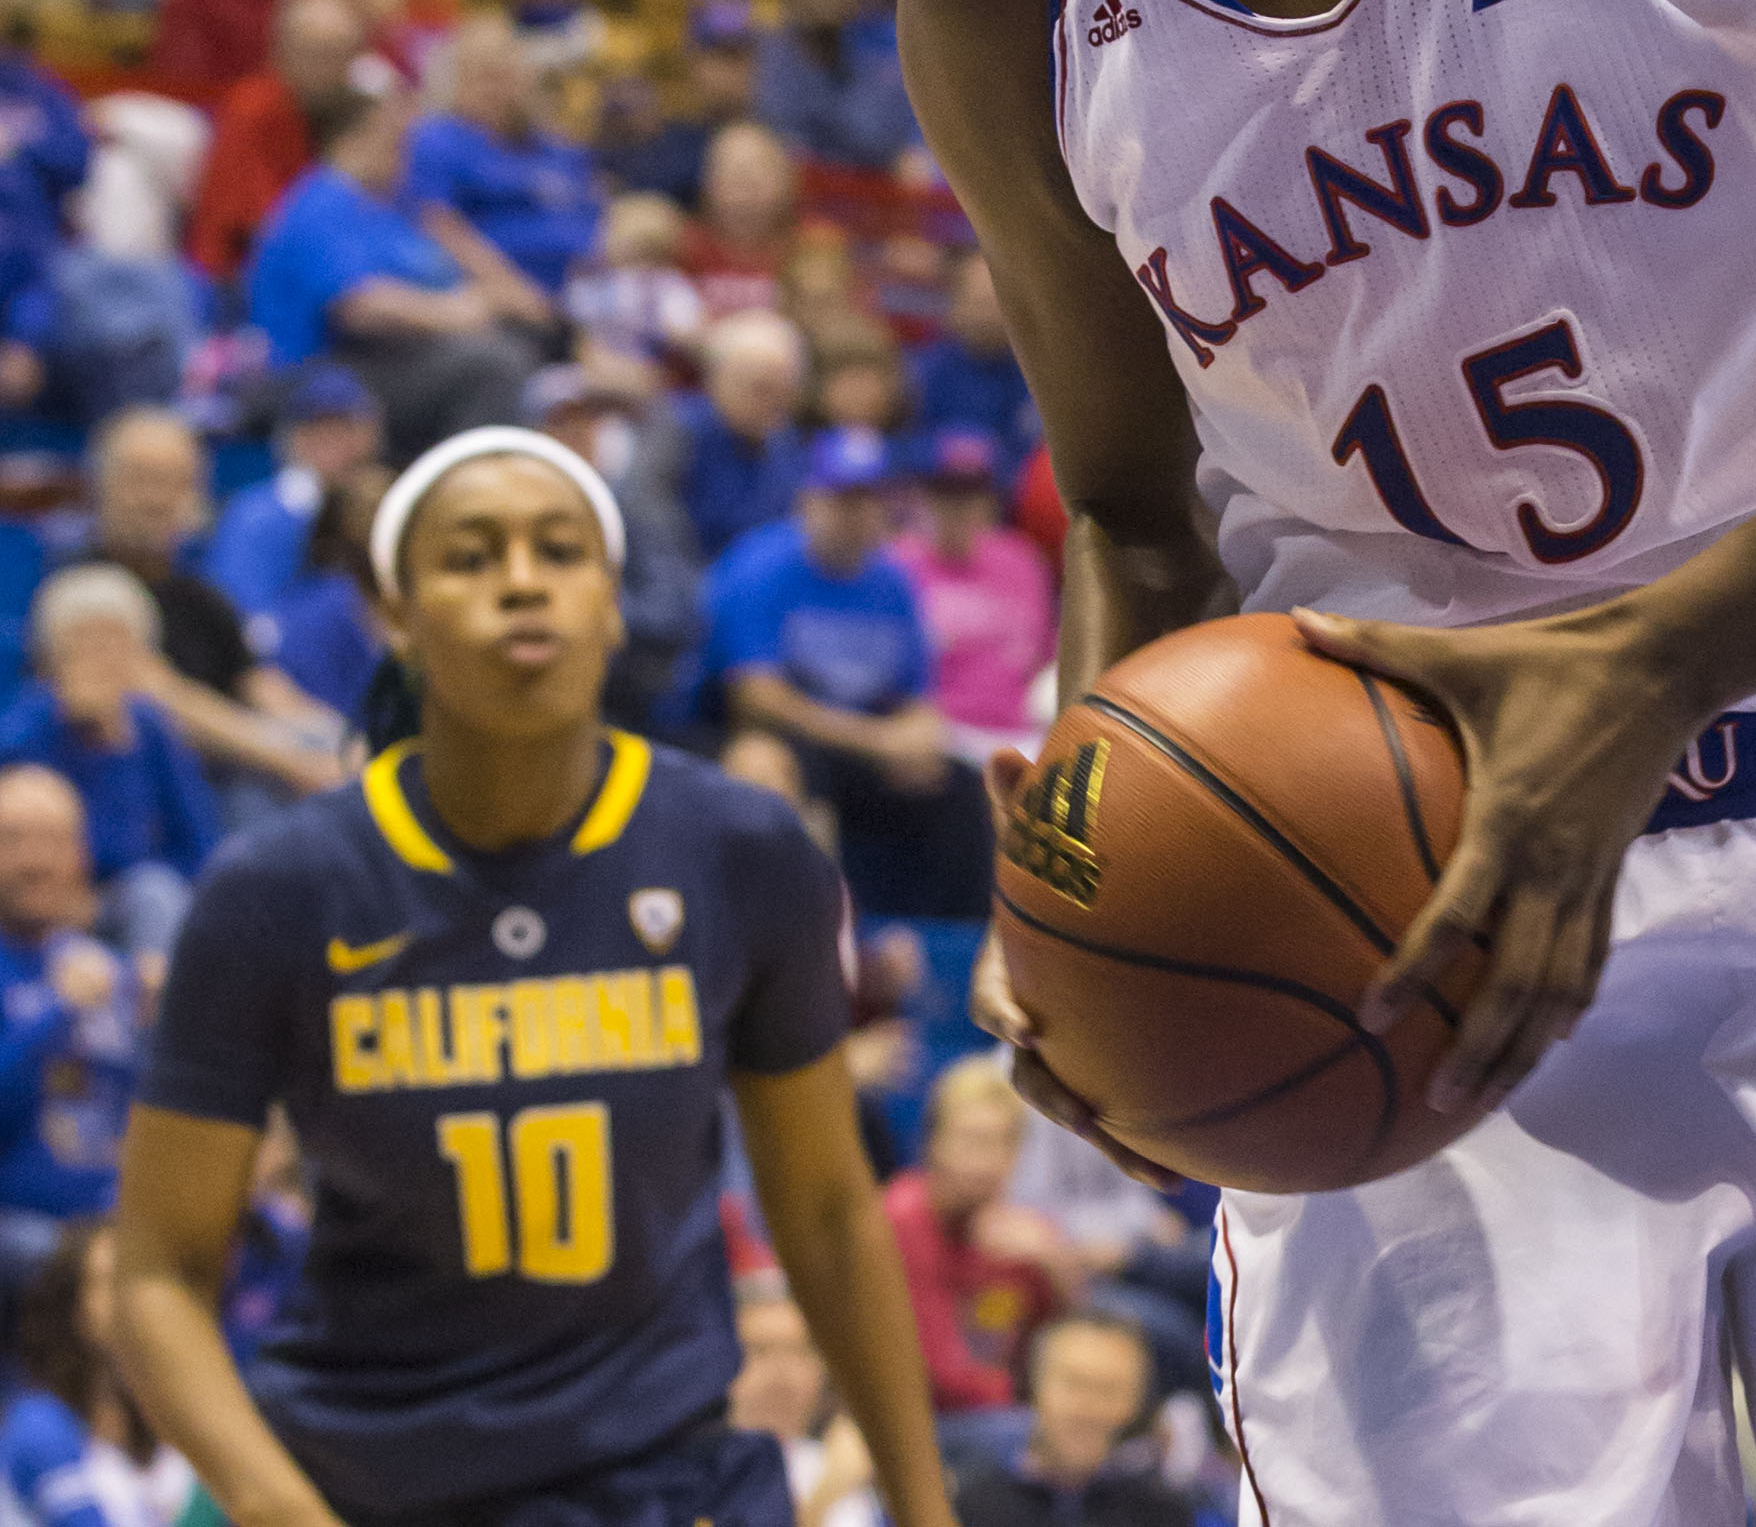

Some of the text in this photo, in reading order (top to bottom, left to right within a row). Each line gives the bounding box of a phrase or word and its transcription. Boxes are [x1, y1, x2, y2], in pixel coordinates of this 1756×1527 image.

[1137, 82, 1726, 369] KANSAS
[1332, 313, 1648, 565] 15
[1666, 721, 1740, 802] U
[329, 964, 704, 1094] CALIFORNIA
[435, 1100, 616, 1285] 10
